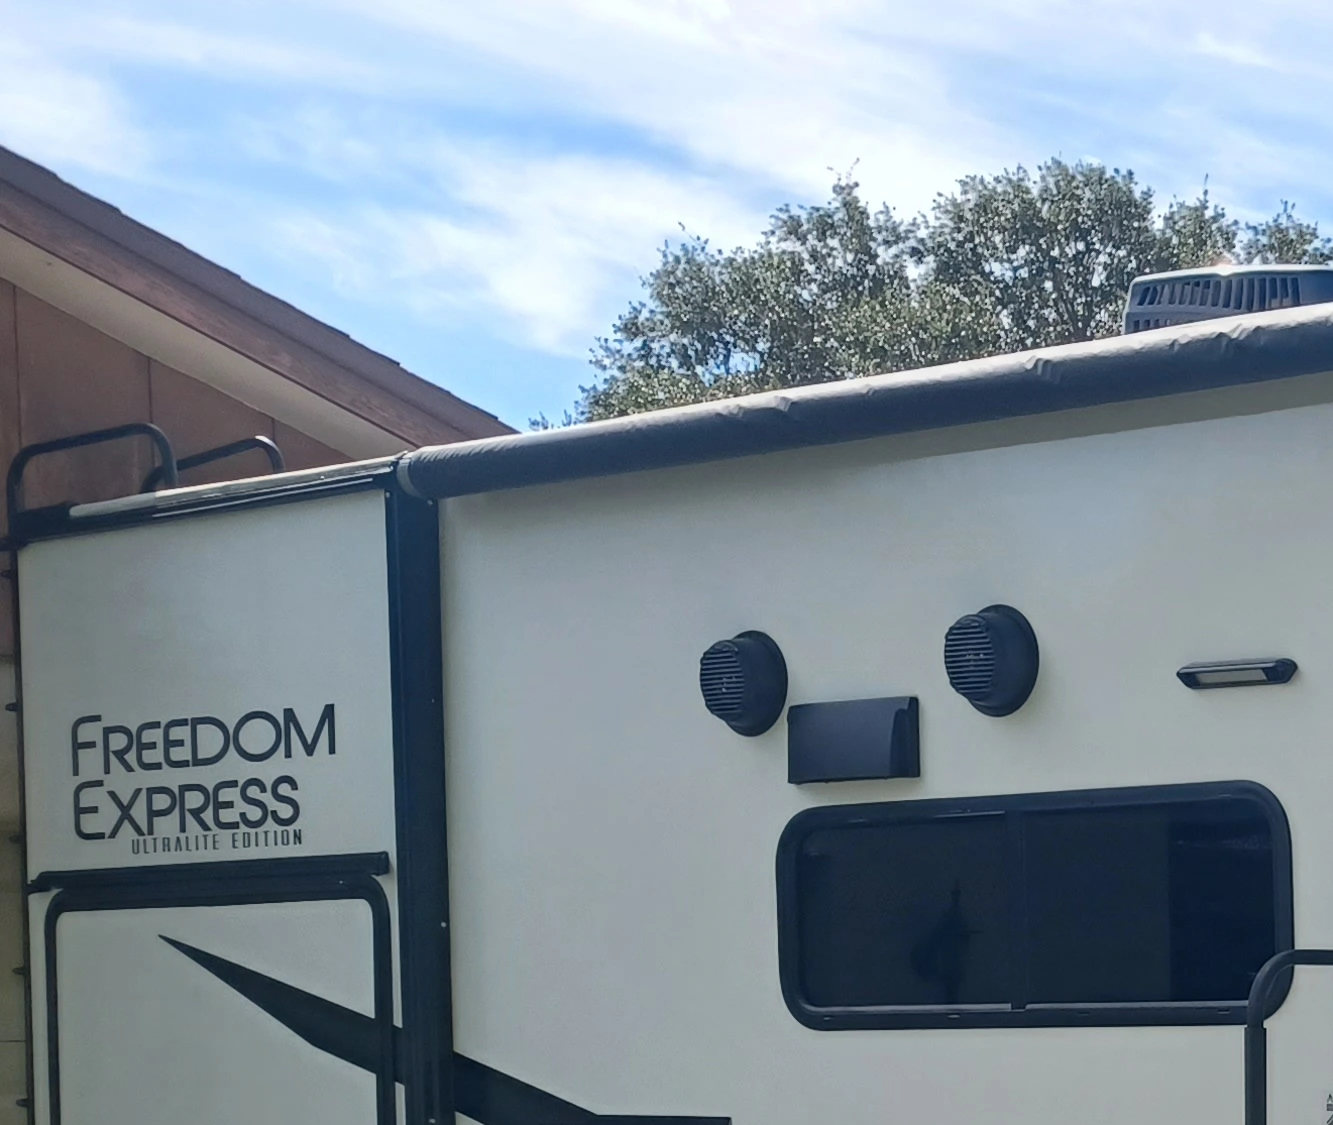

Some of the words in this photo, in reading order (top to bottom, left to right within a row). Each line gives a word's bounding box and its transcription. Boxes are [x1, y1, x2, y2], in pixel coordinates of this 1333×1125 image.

[71, 703, 336, 776] FREEDOM
[73, 775, 301, 840] EXPRESS
[131, 833, 220, 855] ULTRALITE
[231, 828, 303, 850] EDITION
